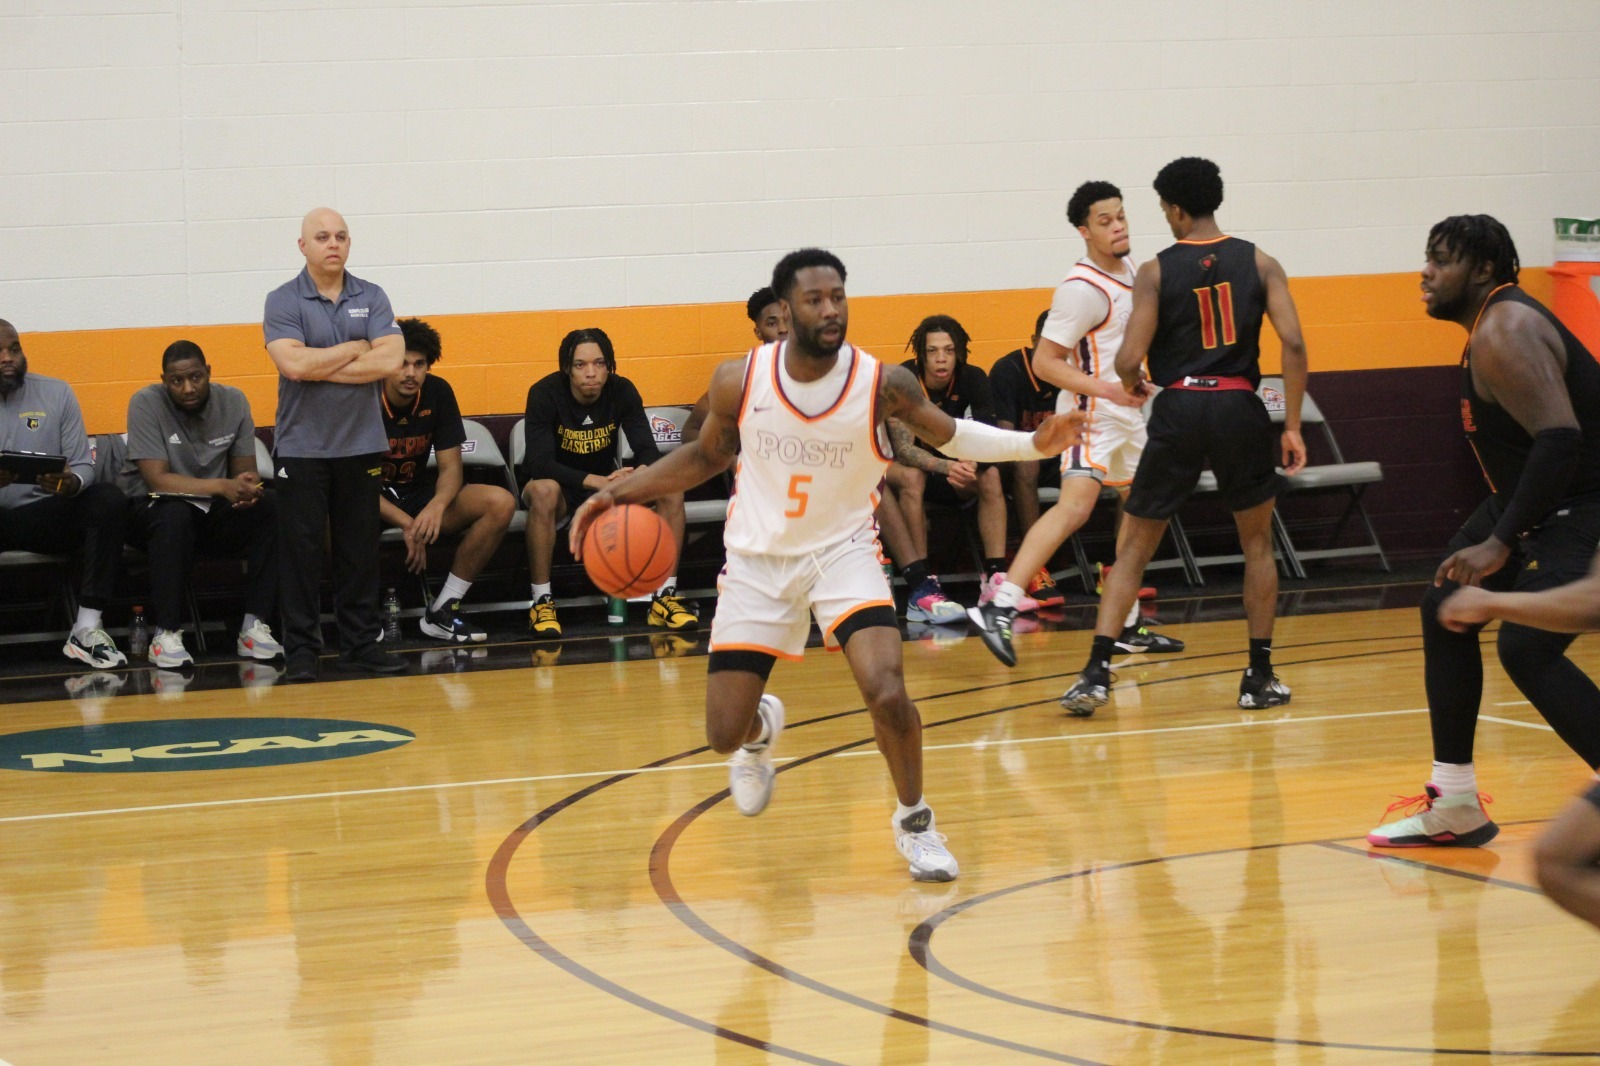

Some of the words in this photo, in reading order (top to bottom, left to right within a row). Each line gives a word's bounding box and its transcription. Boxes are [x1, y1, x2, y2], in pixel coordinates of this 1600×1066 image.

[1193, 282, 1236, 349] 11
[557, 424, 593, 440] BOOMFIELD
[594, 422, 616, 439] COLLGE
[561, 437, 611, 454] BASKETBA
[652, 432, 682, 441] AGLE
[757, 429, 852, 468] POST
[784, 474, 812, 518] 5
[21, 729, 415, 768] NCAA
